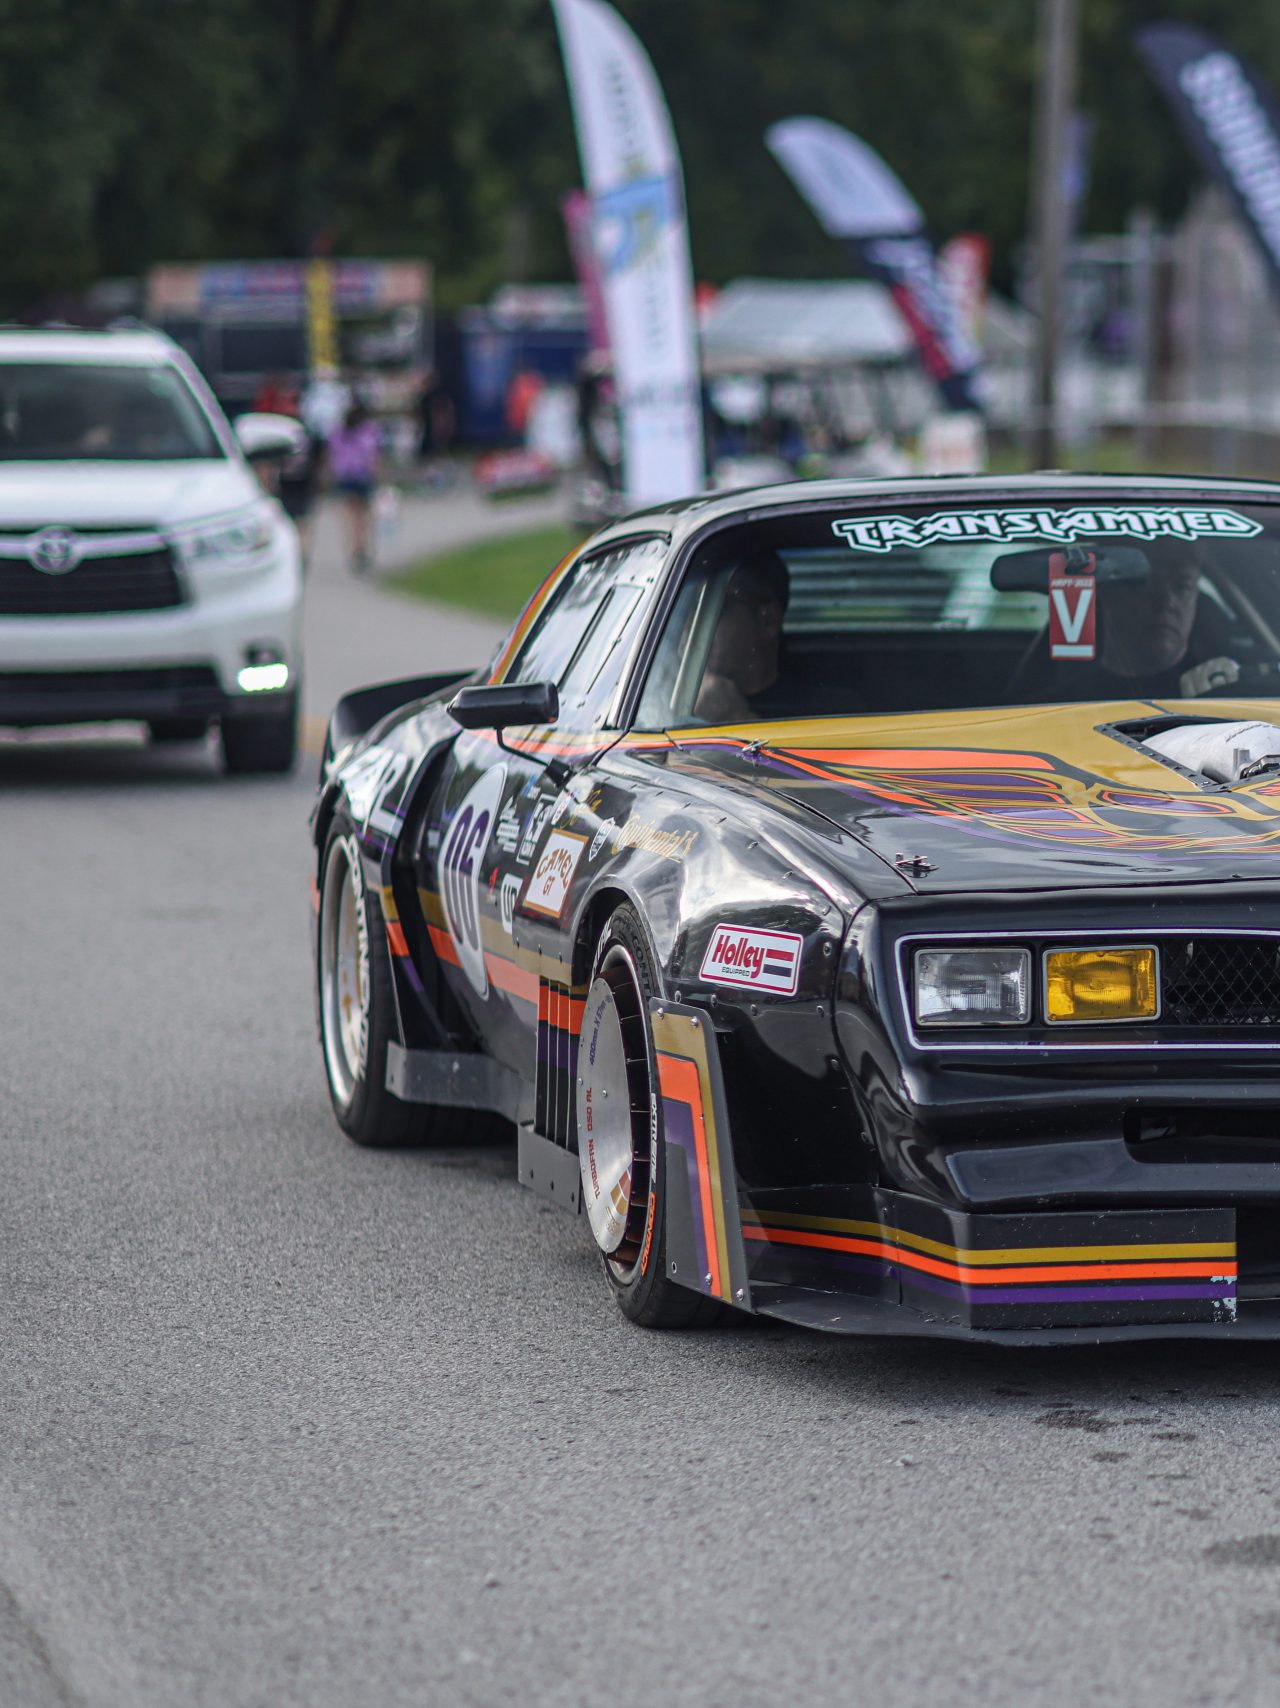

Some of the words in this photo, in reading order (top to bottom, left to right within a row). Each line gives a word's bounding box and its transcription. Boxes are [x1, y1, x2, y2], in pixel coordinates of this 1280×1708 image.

[838, 508, 1257, 550] TRANSLAMMED
[1052, 589, 1093, 643] V
[444, 804, 490, 951] 06
[536, 848, 573, 890] CAMEL
[543, 875, 556, 896] GT
[711, 934, 765, 979] Holley
[721, 966, 751, 977] EQUIPPED
